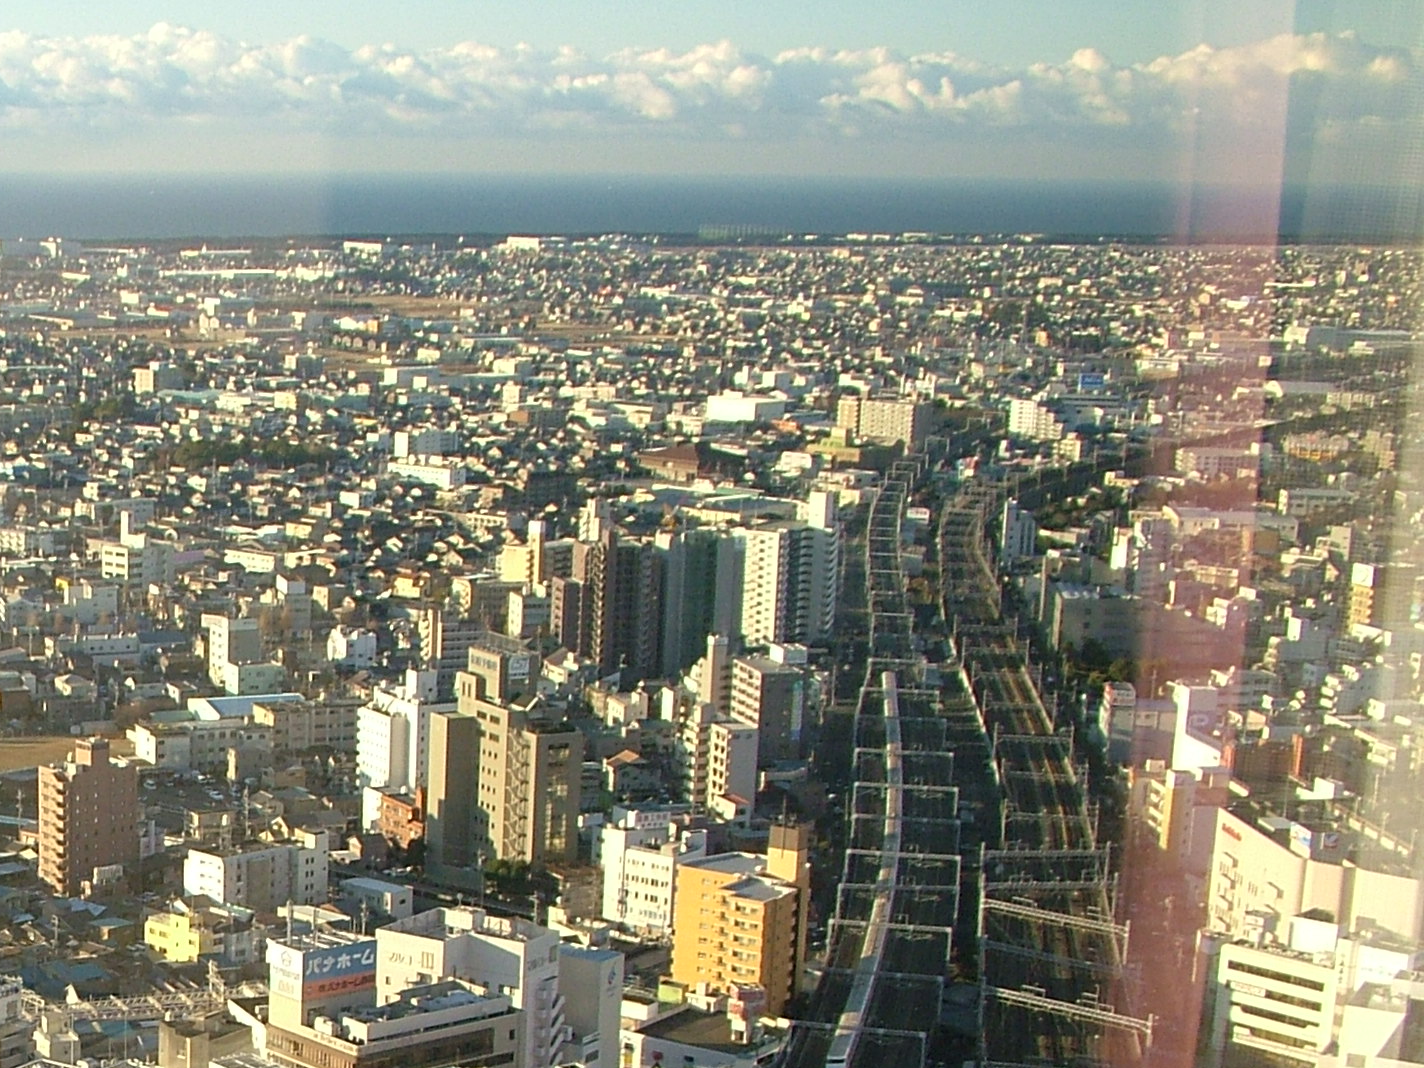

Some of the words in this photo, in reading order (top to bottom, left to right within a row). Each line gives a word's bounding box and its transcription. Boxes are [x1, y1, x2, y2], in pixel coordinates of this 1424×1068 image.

[305, 948, 374, 976] パナホーム
